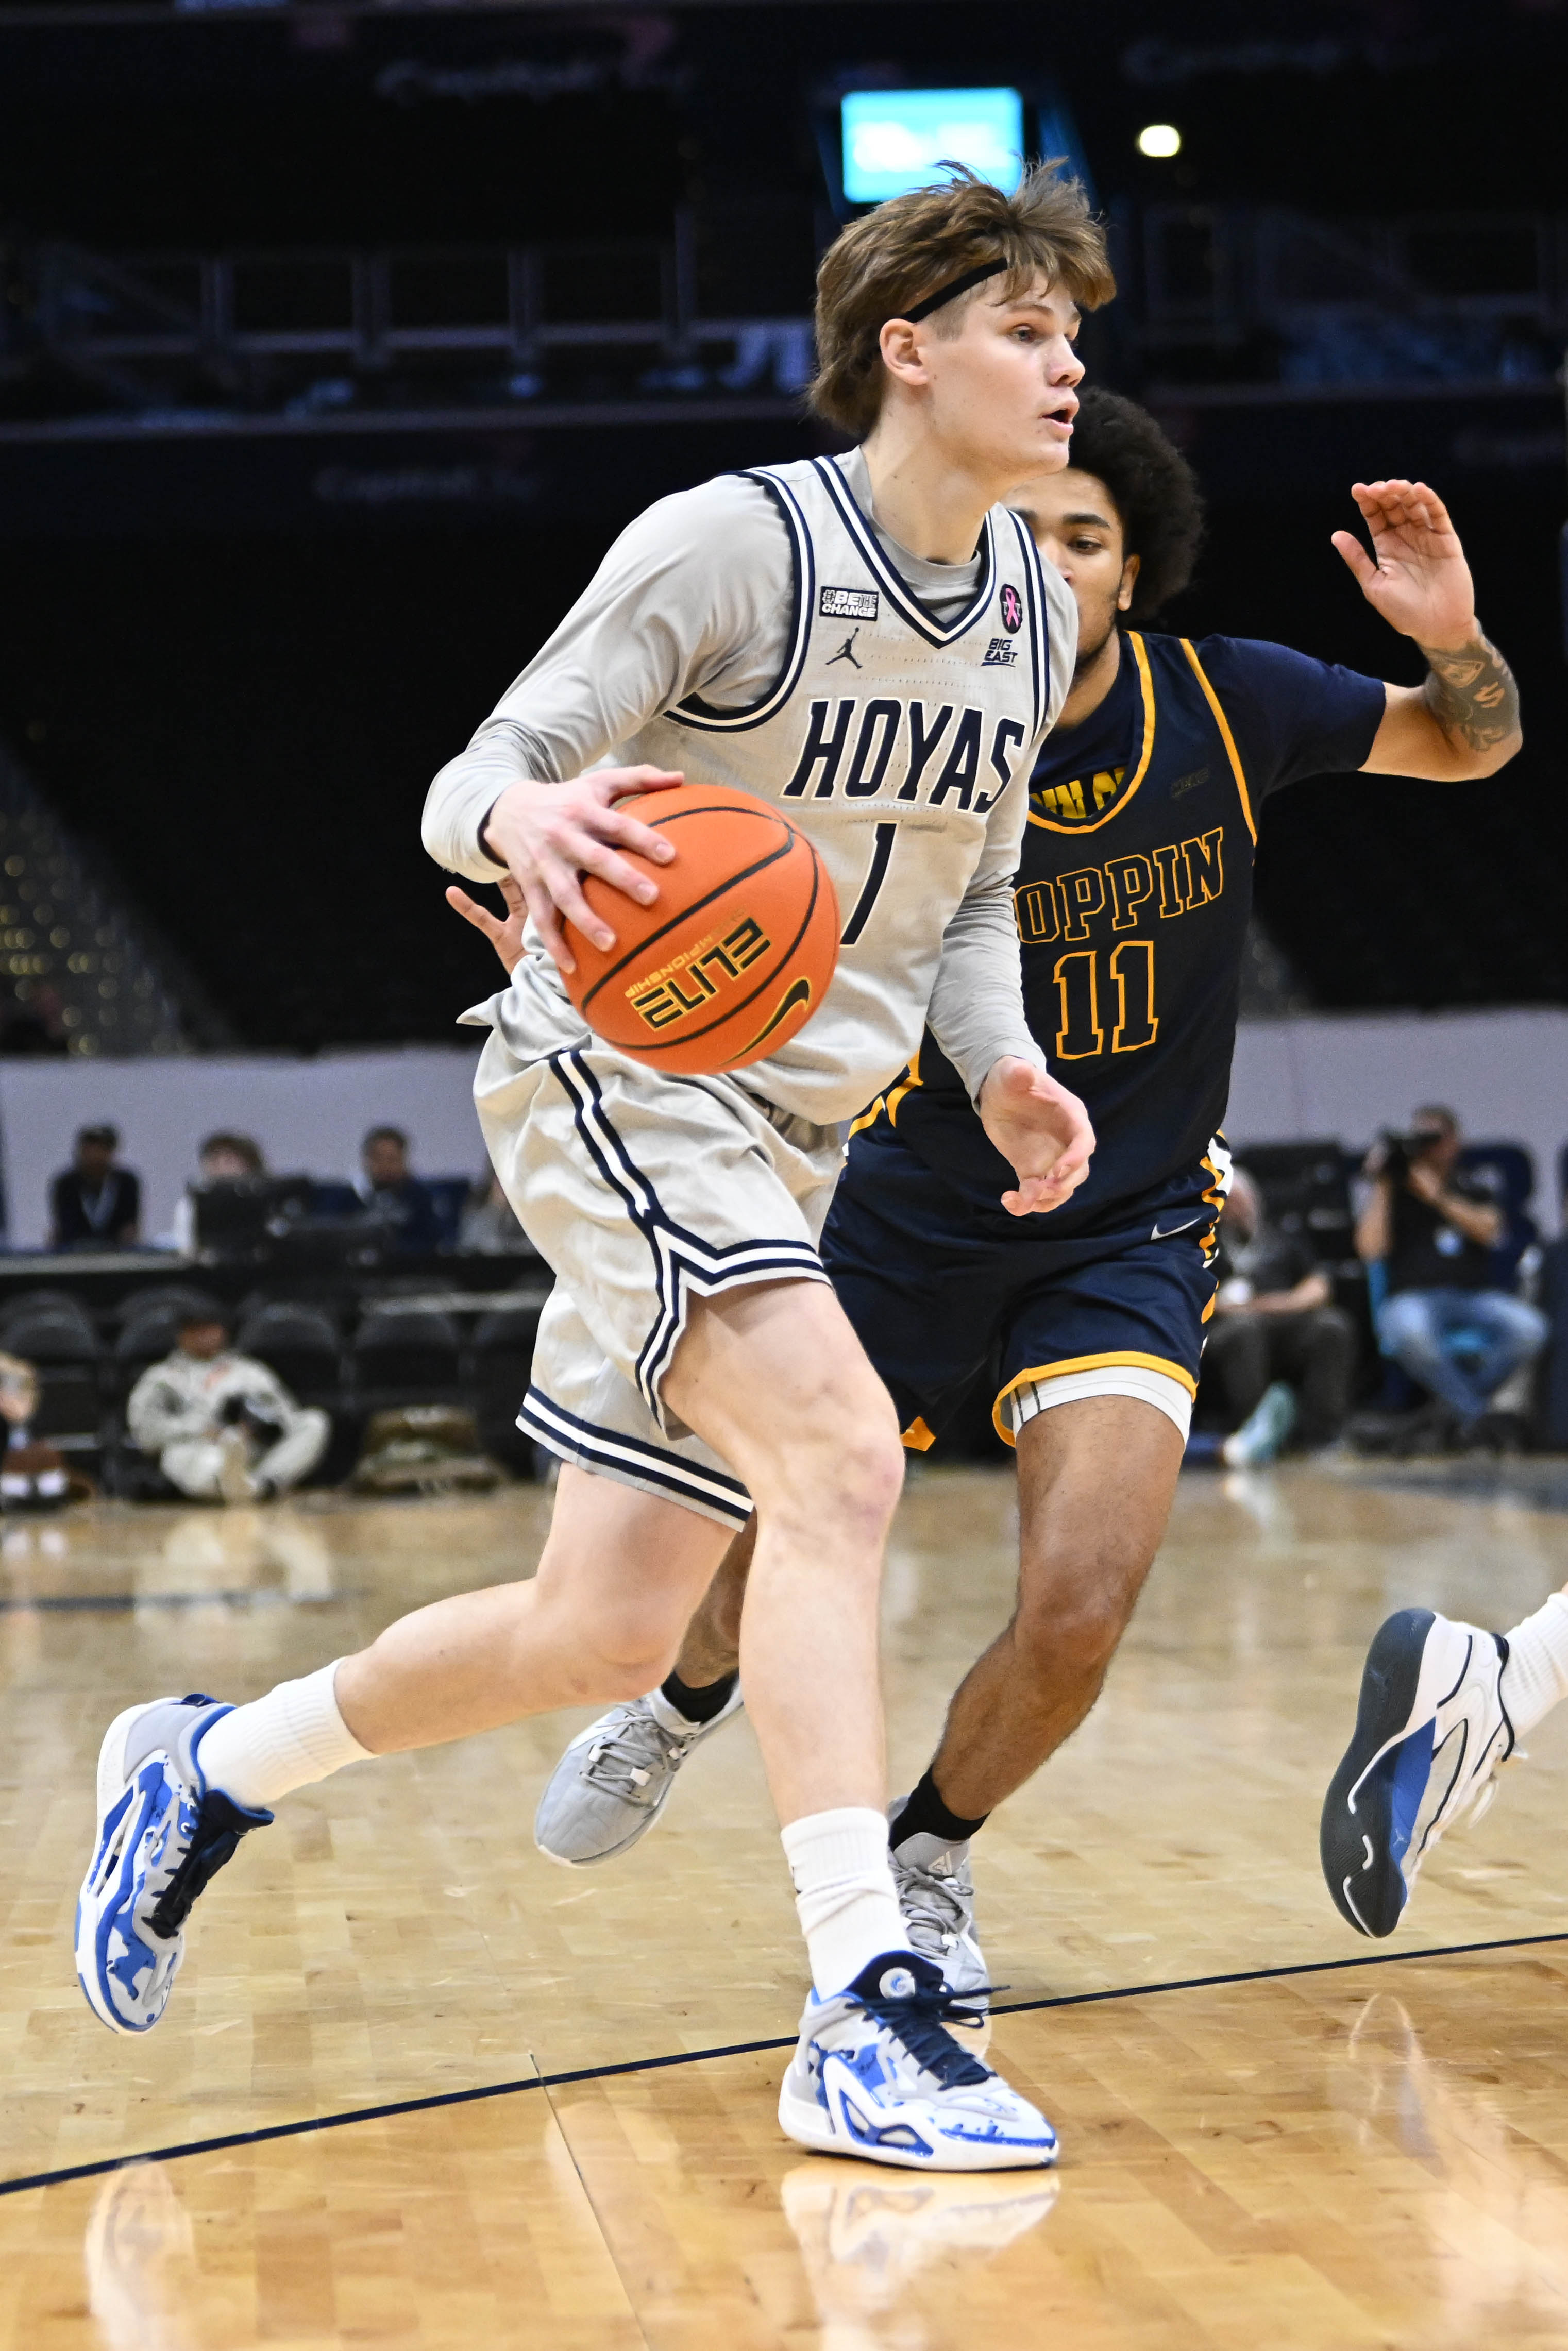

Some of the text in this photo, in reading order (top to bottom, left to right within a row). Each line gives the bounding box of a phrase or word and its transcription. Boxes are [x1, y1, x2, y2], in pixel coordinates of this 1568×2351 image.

[822, 603, 876, 618] CHANGE
[985, 650, 1018, 663] EAST
[989, 638, 1013, 651] BIG
[780, 697, 1026, 816] HOYAS
[839, 819, 900, 948] 1
[1013, 826, 1224, 944] OPPIN
[624, 909, 746, 999] MPIONSHIP
[630, 917, 771, 1032] ELITE
[1053, 940, 1159, 1060] 11
